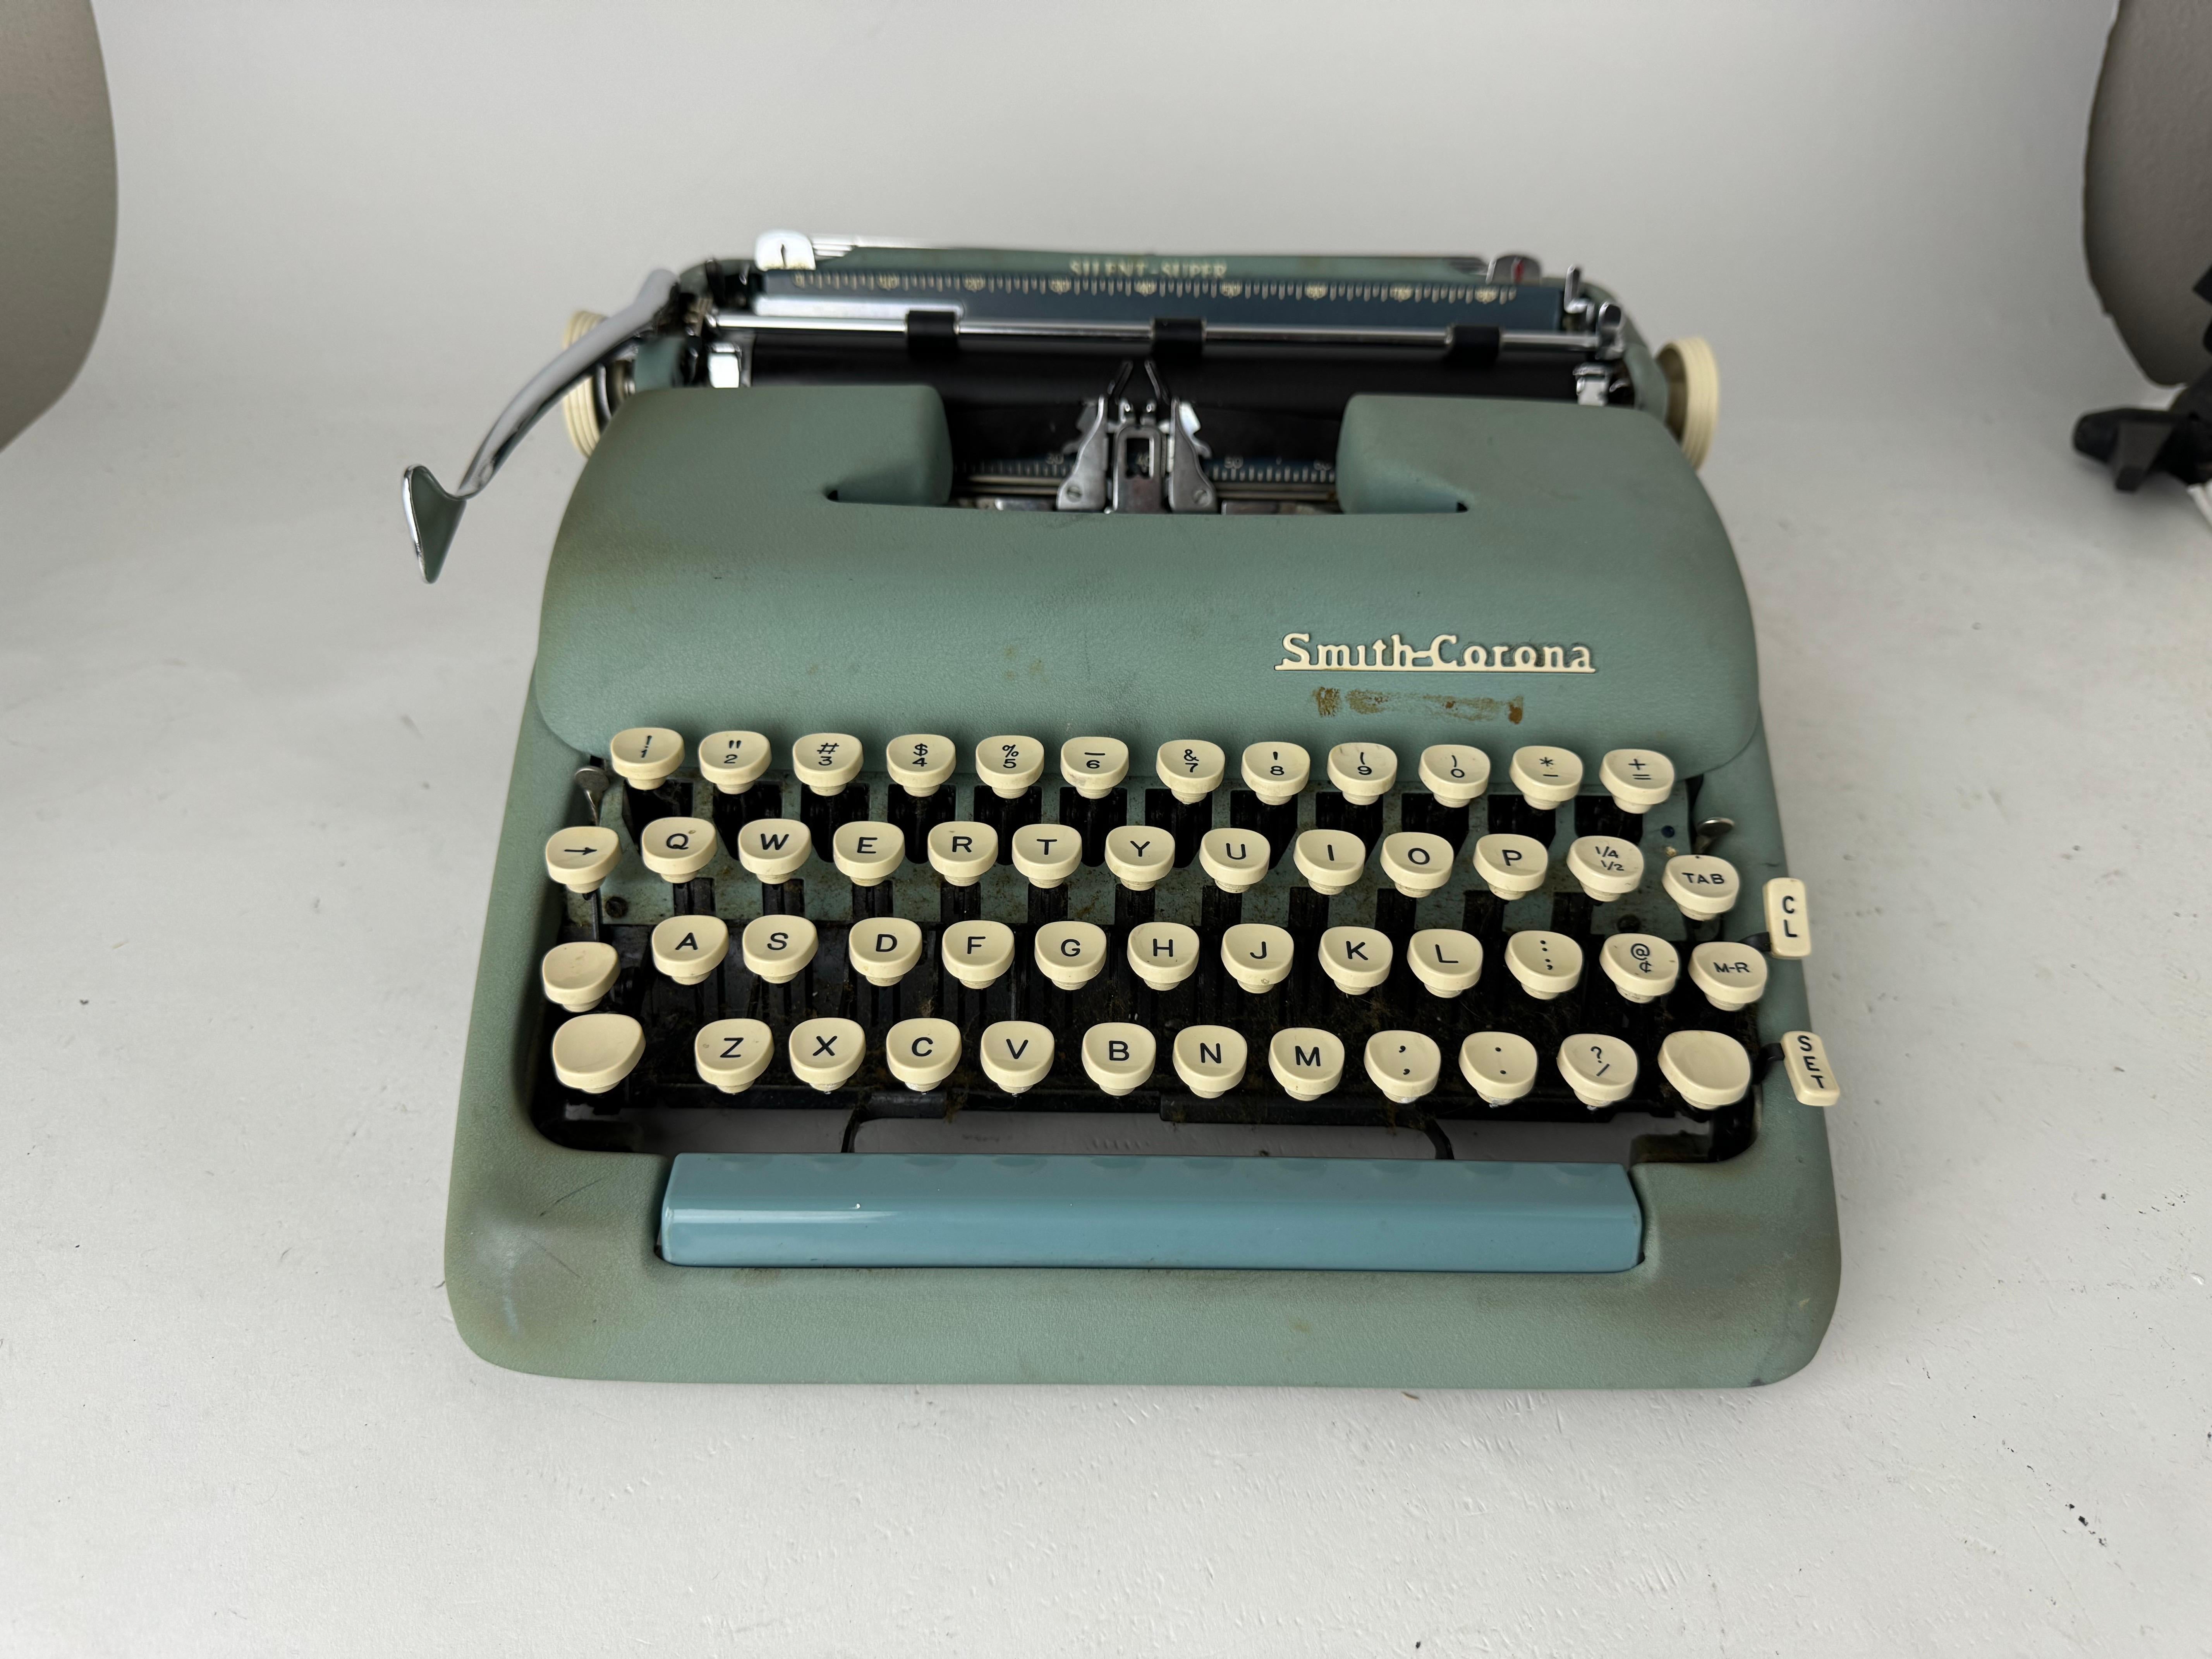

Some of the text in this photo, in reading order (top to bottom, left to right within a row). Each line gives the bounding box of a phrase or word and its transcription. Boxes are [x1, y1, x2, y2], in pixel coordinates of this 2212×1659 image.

[1274, 633, 1595, 673] Smith-Corona
[644, 735, 653, 749] !
[816, 742, 840, 755] #
[912, 743, 929, 757] $
[1001, 744, 1019, 758] %
[641, 749, 648, 759] 1
[723, 754, 738, 764] 2
[817, 756, 833, 766] 3
[912, 757, 928, 768] 4
[1183, 749, 1200, 762] &
[1002, 758, 1017, 769] 5
[1085, 759, 1101, 769] 6
[1185, 762, 1199, 773] 7
[1269, 765, 1285, 776] 8
[1357, 765, 1373, 776] 9
[665, 833, 689, 850] Q
[760, 833, 790, 851] W
[856, 836, 878, 854] E
[951, 836, 973, 853] R
[1036, 838, 1058, 856] T
[1130, 840, 1151, 857] Y
[1225, 842, 1247, 860] U
[1327, 844, 1335, 862] I
[1407, 847, 1431, 866] O
[1501, 849, 1522, 867] P
[1681, 872, 1725, 885] TAB
[675, 932, 699, 951] A
[766, 932, 789, 951] S
[875, 933, 898, 953] D
[967, 936, 986, 955] F
[1060, 938, 1081, 957] G
[1152, 938, 1174, 958] H
[1249, 941, 1267, 960] J
[1345, 940, 1369, 961] K
[1434, 944, 1459, 964] L
[1630, 943, 1651, 961] @
[1713, 962, 1750, 974] M-R
[719, 1037, 744, 1058] Z
[812, 1035, 838, 1057] X
[911, 1036, 934, 1057] C
[1005, 1038, 1029, 1060] V
[1108, 1040, 1130, 1061] B
[1199, 1042, 1222, 1064] N
[1590, 1046, 1602, 1064] ?
[1294, 1045, 1321, 1067] M
[1797, 1035, 1825, 1089] SET
